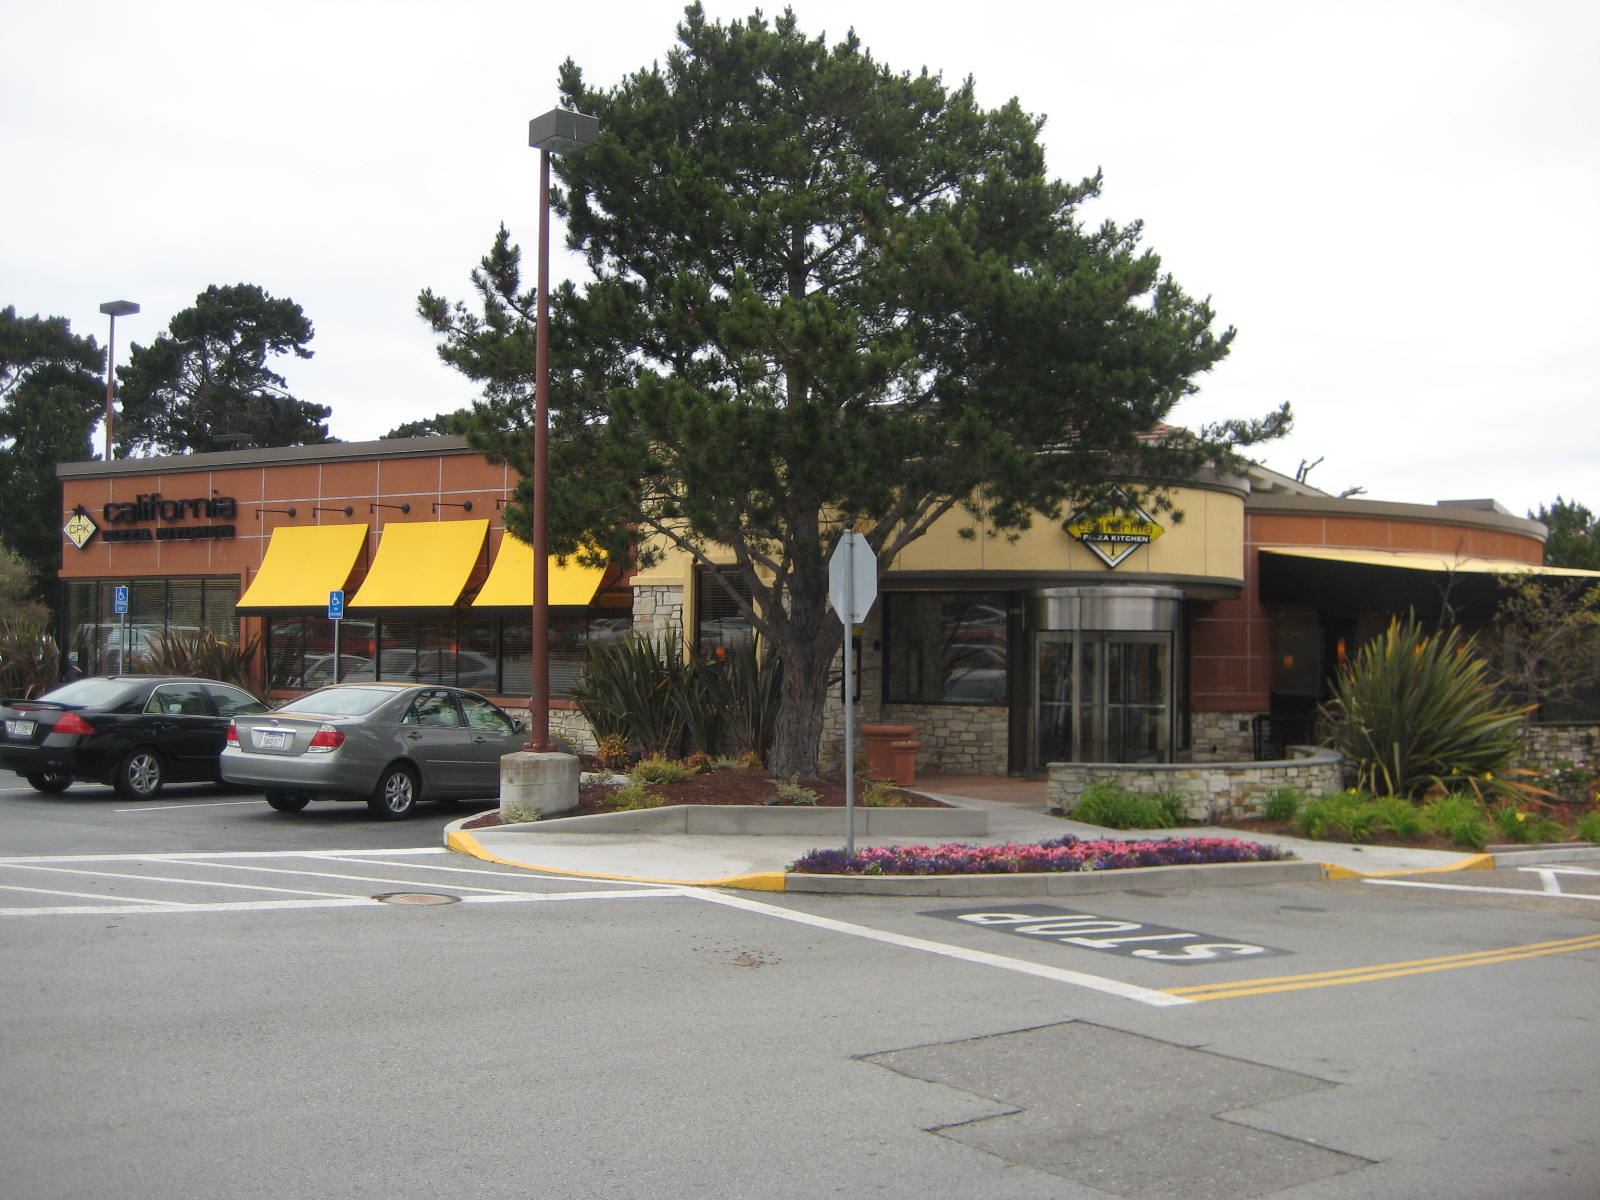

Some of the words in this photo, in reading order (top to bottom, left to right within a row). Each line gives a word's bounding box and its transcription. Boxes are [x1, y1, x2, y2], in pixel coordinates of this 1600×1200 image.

[103, 490, 236, 524] california
[69, 524, 91, 535] CPK
[1111, 534, 1149, 543] KITCHEN
[957, 912, 1265, 960] STOP
